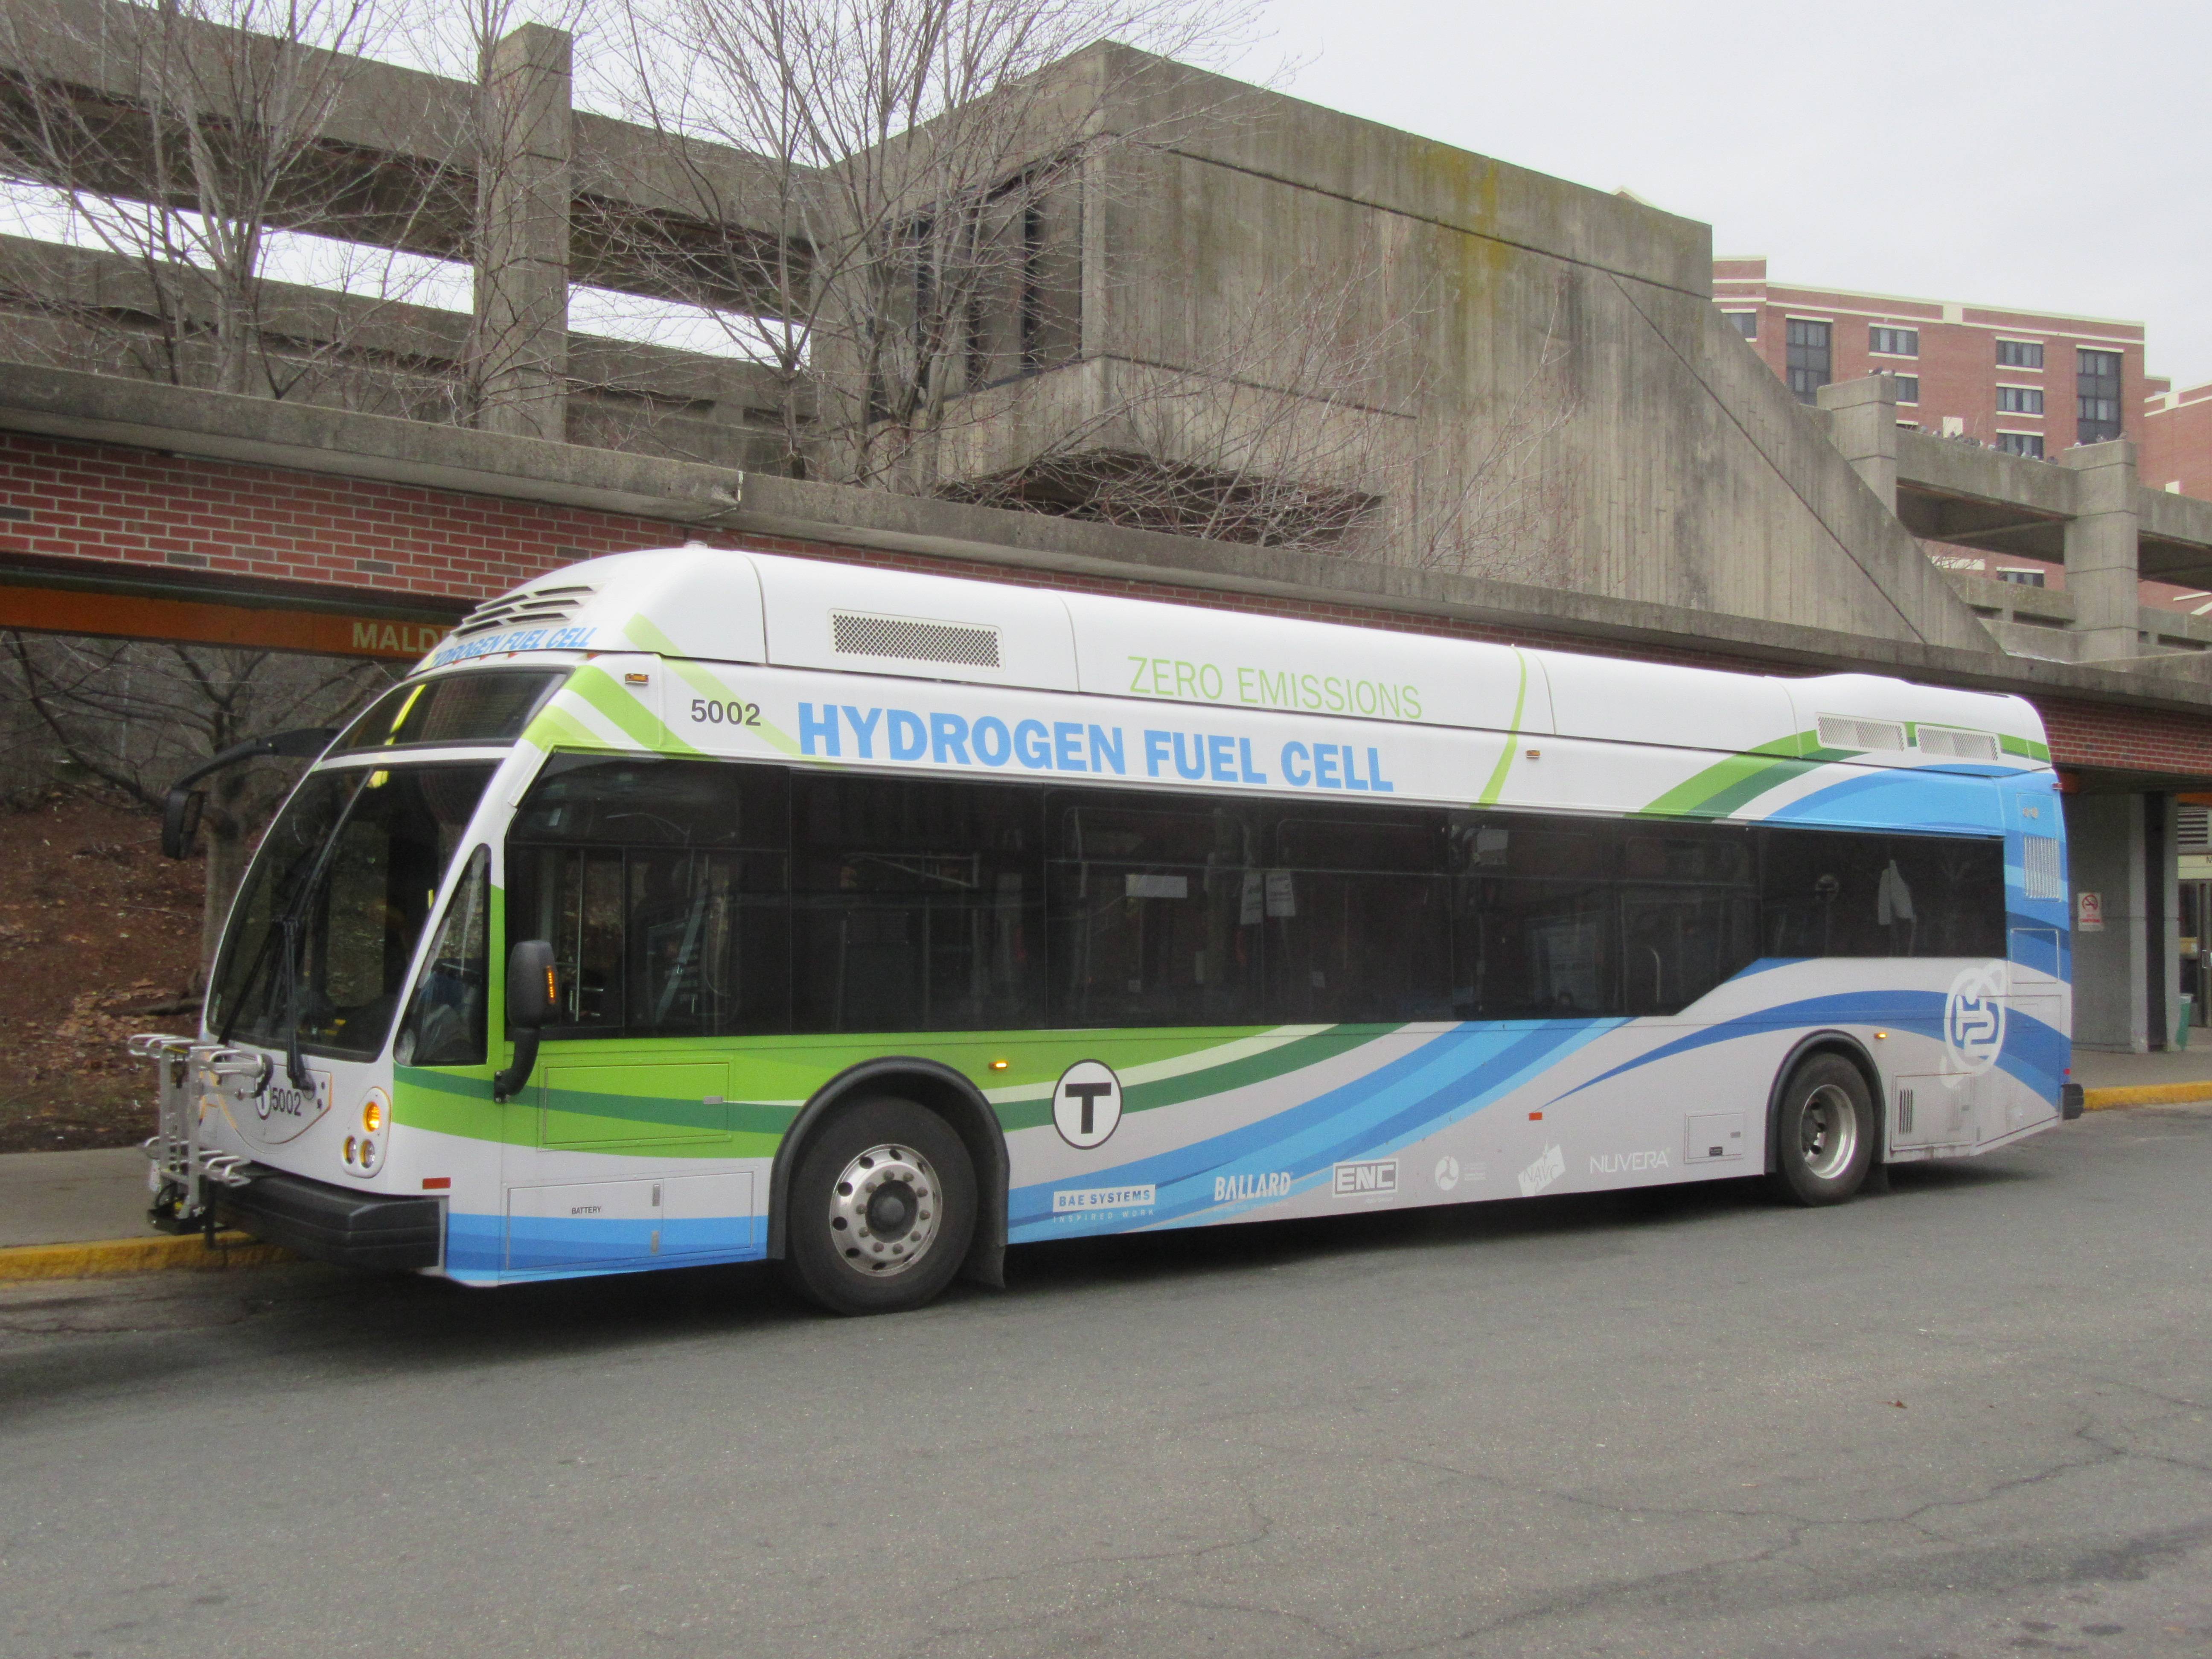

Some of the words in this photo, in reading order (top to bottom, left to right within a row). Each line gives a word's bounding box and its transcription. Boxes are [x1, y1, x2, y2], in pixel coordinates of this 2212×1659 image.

[353, 622, 451, 653] MALD
[499, 629, 548, 651] FUEL
[546, 627, 597, 648] CELL
[1127, 656, 1223, 700] ZERO
[1237, 667, 1422, 719] EMISSIONS
[691, 699, 761, 727] 5002
[798, 701, 1126, 775] HYDROGEN
[1144, 729, 1267, 784] FUEL
[1281, 741, 1394, 792] CELL
[271, 1087, 301, 1116] 5002
[1065, 1082, 1112, 1134] T
[1523, 1164, 1559, 1182] NAVC
[1590, 1151, 1669, 1173] NUVERA
[1336, 1164, 1394, 1191] ENC
[572, 1206, 601, 1214] BATTERY
[1059, 1195, 1084, 1206] BAE
[1090, 1190, 1150, 1204] SYSTEMS
[1054, 1212, 1113, 1222] INSPIRED
[1122, 1209, 1153, 1217] WORK
